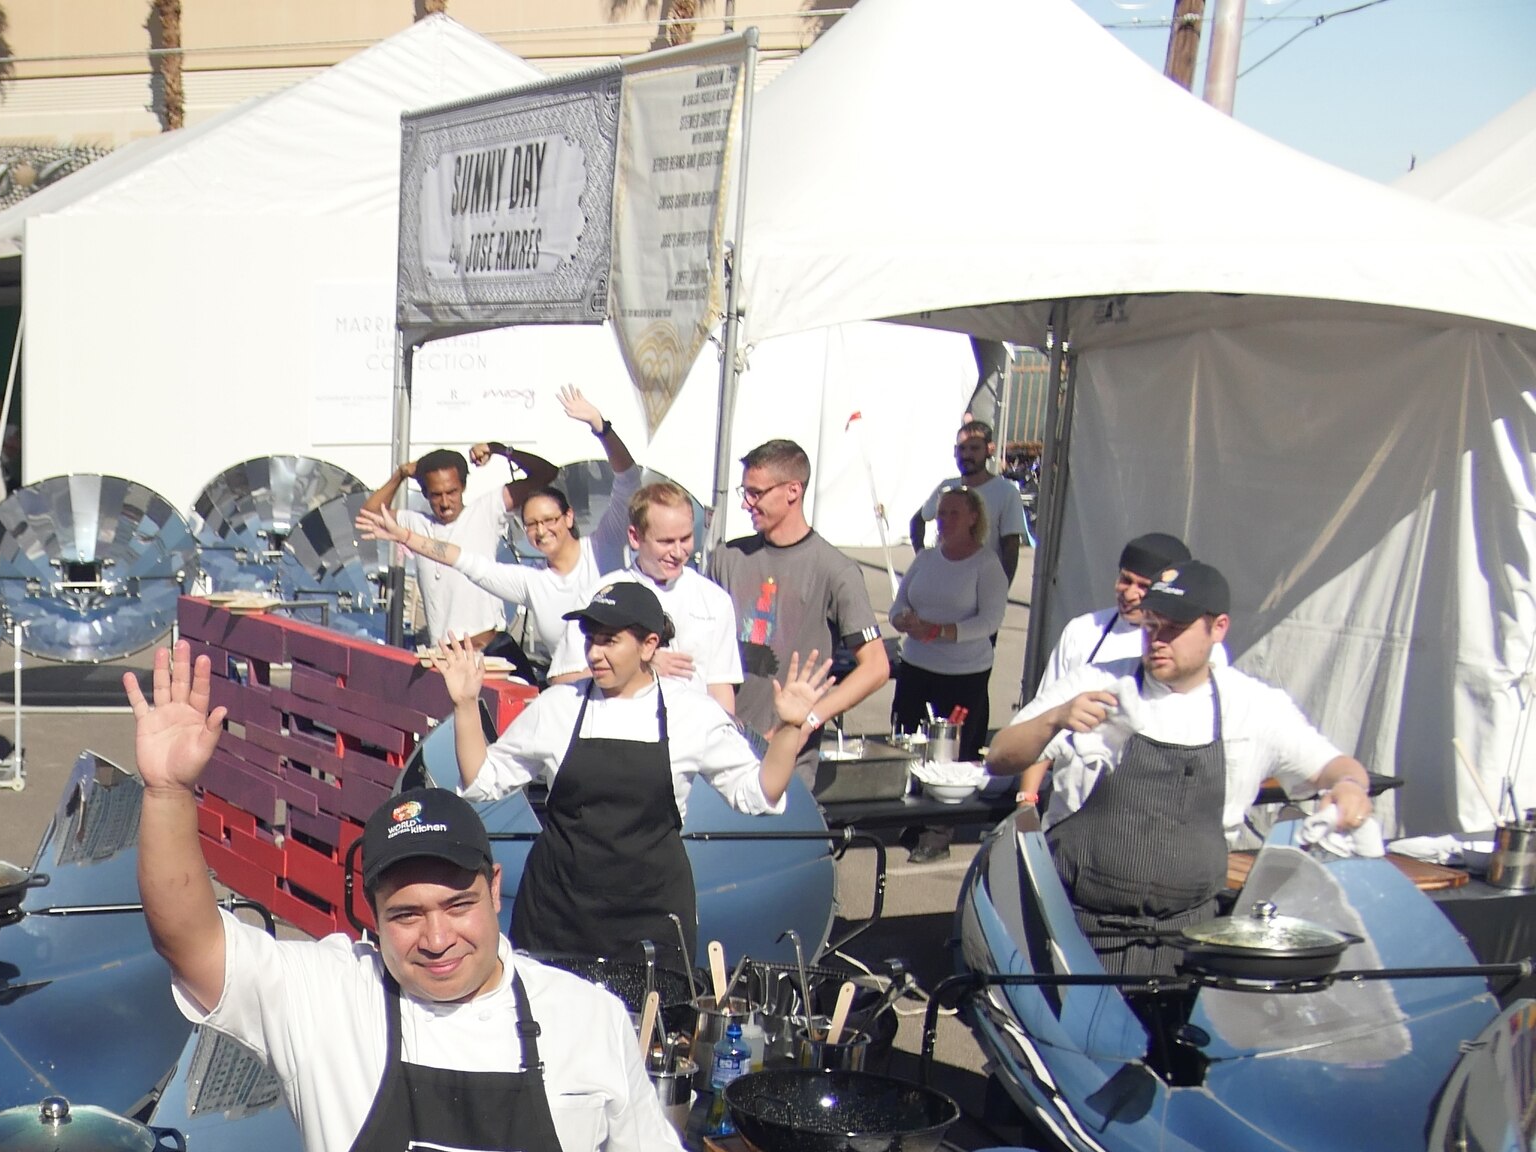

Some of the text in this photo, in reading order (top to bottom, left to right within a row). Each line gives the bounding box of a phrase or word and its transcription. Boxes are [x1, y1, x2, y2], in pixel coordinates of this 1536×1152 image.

[451, 141, 546, 217] SUNNY DAY
[465, 219, 496, 272] JOSÉ
[495, 216, 542, 271] ANDRÉS
[366, 354, 487, 371] COECTION
[388, 820, 417, 834] WORLD
[410, 824, 447, 834] kitchen
